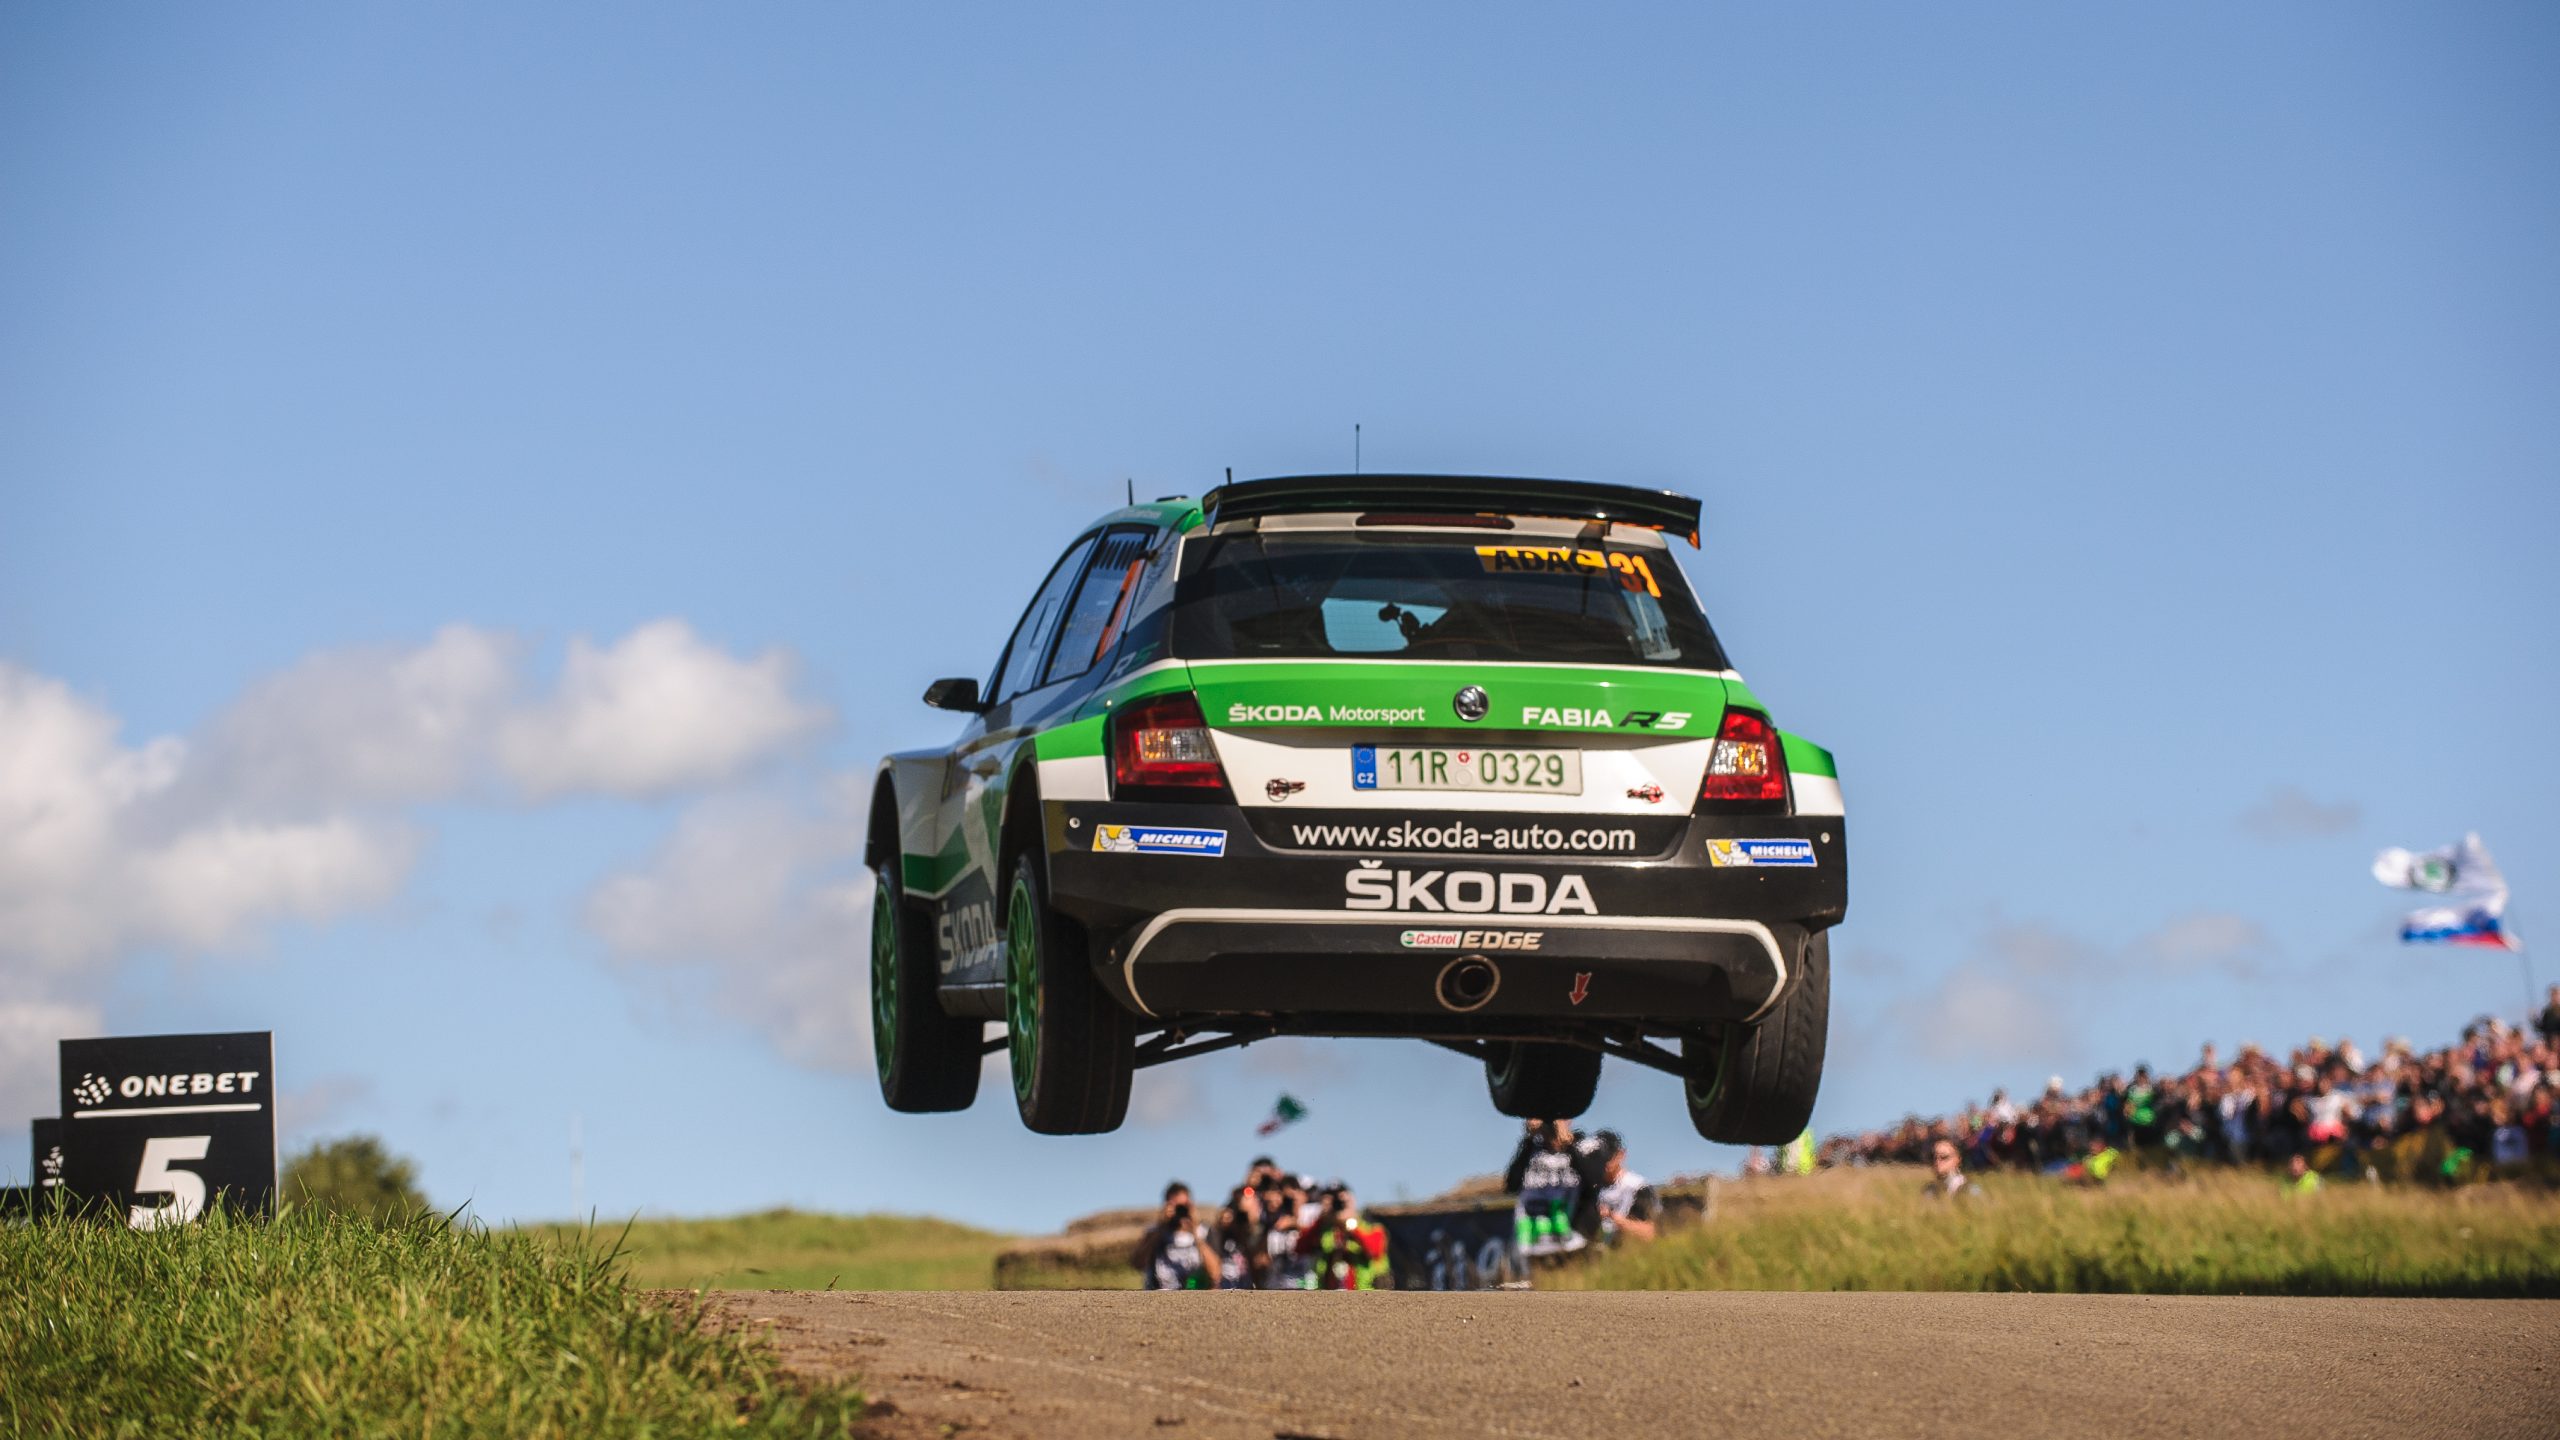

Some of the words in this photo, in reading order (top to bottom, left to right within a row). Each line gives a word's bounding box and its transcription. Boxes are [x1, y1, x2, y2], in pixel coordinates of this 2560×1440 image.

[1494, 549, 1597, 575] ADAC
[1608, 552, 1662, 598] 31
[1228, 703, 1323, 722] ŠKODA
[1329, 706, 1425, 725] Motorsport
[1522, 706, 1613, 728] FABIA
[1618, 711, 1692, 730] R5
[1356, 772, 1375, 785] CZ
[1387, 750, 1448, 784] 11R
[1480, 752, 1564, 787] 0329
[1138, 833, 1224, 847] MICHELIN
[1292, 820, 1636, 850] www.skoda-auto.com
[1749, 845, 1812, 858] MICHELIN
[1344, 859, 1600, 916] ŠKODA
[938, 900, 998, 974] ŠKODA
[1415, 932, 1457, 946] Castrol
[1460, 930, 1545, 950] EDGE
[119, 1071, 260, 1098] ONEBET
[128, 1135, 212, 1233] 5
